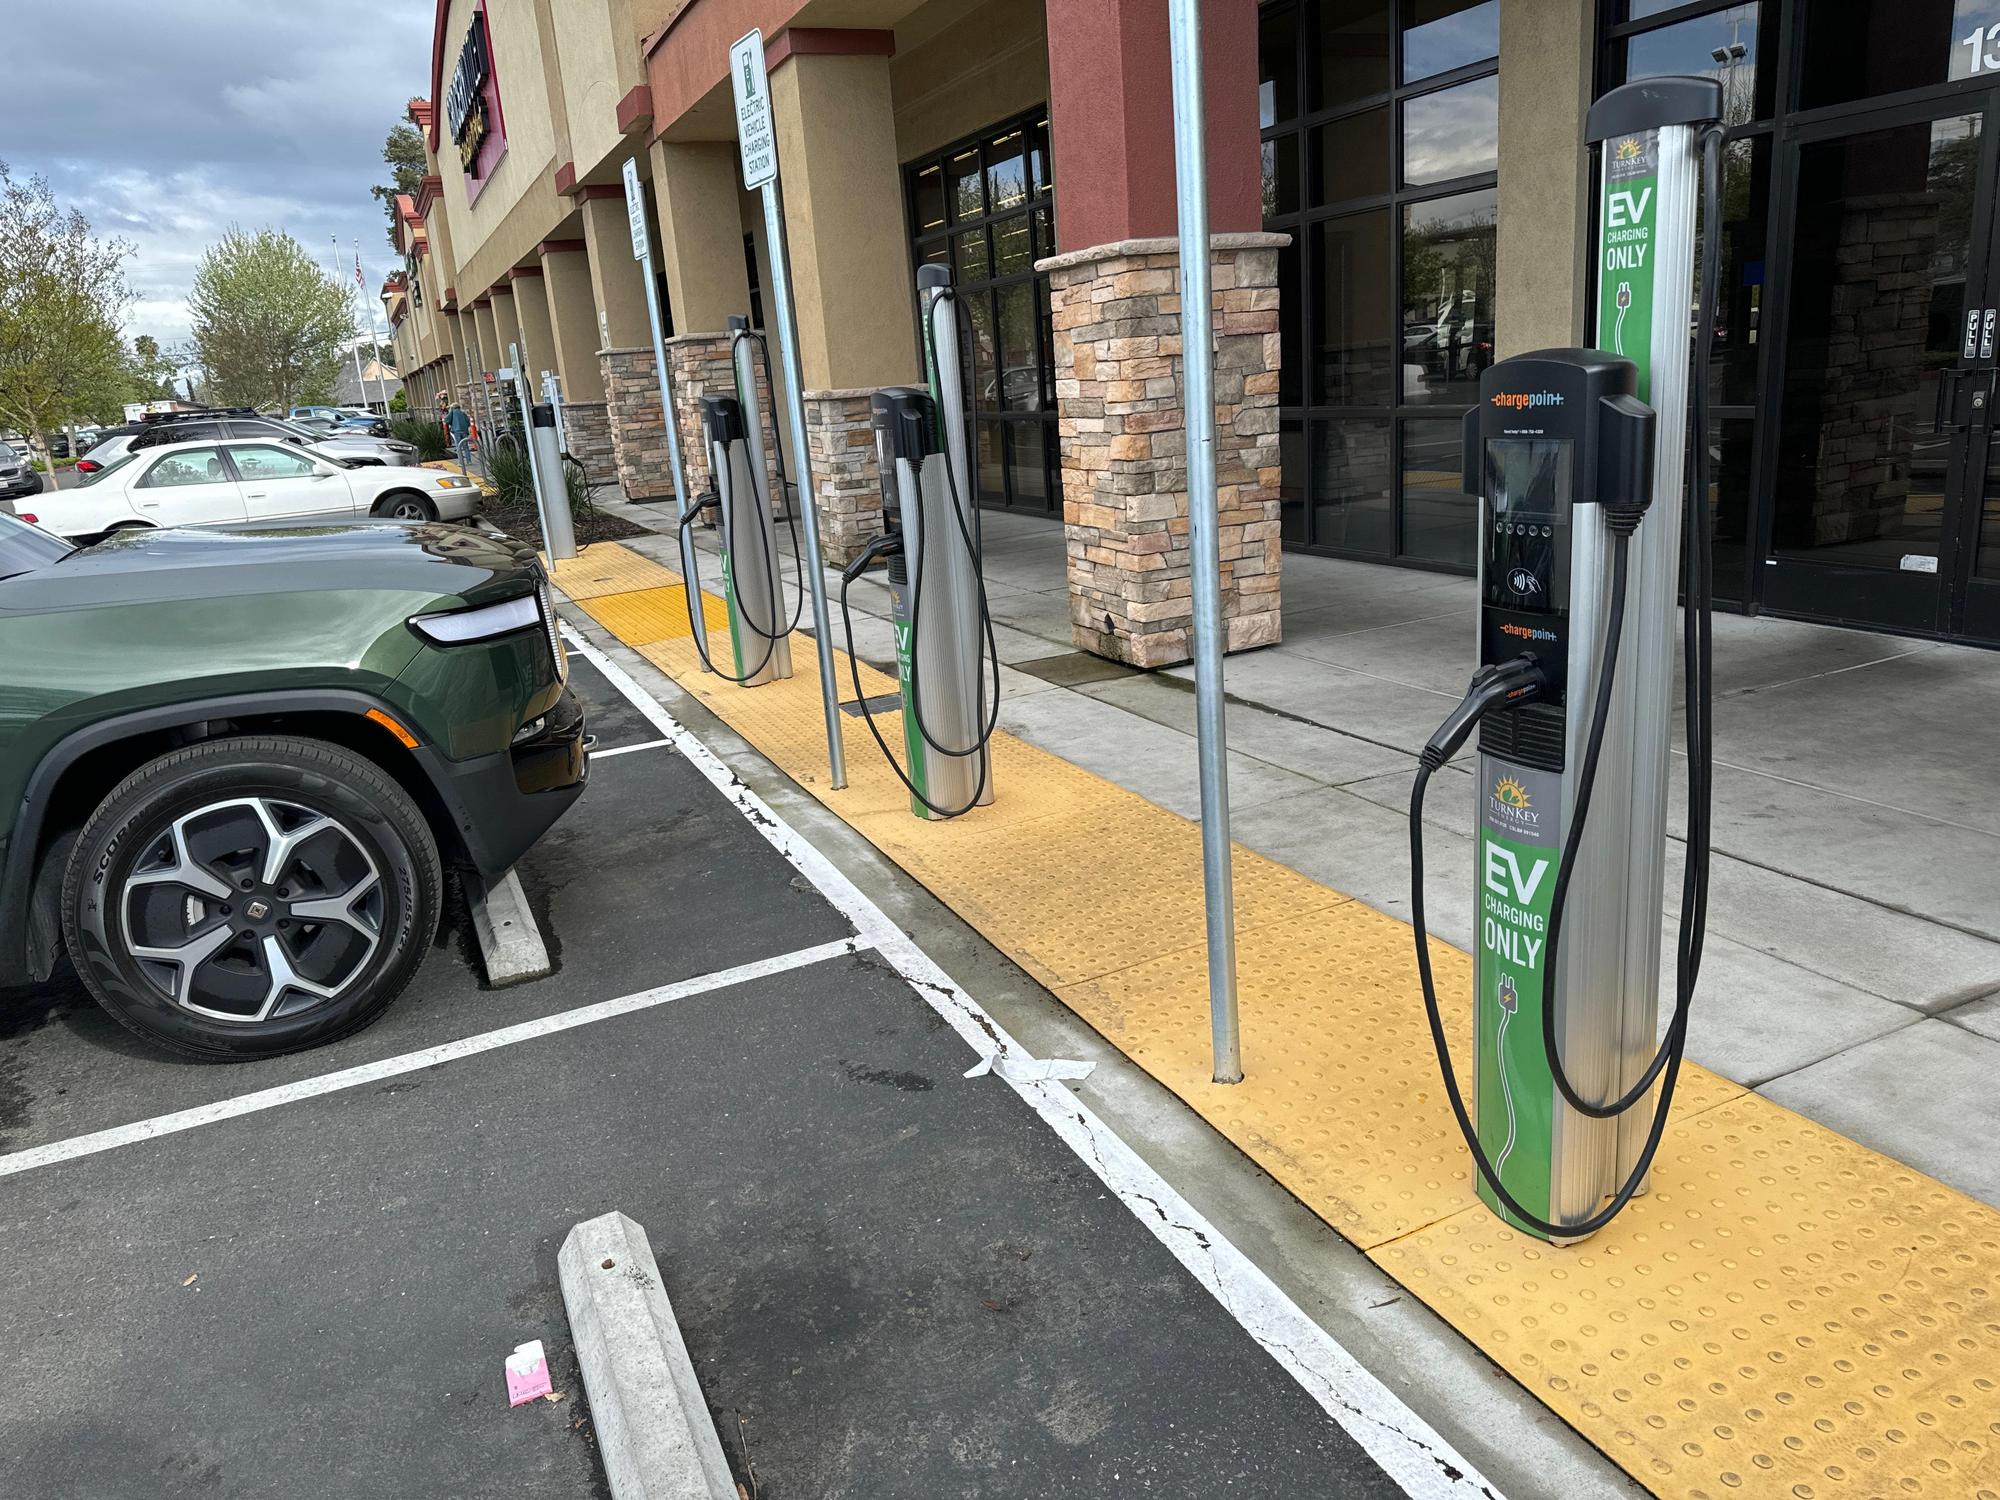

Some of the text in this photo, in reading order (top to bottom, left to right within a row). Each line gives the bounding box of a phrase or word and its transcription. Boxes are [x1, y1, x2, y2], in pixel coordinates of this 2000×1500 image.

[741, 96, 764, 121] ELECTRIC
[744, 115, 766, 139] VEHICLE
[744, 133, 770, 158] CHARGING
[748, 154, 769, 173] STATION
[1608, 186, 1652, 228] EV
[1607, 226, 1648, 244] CHARGING
[1606, 243, 1647, 271] ONLY
[1967, 314, 1978, 347] PULL
[1983, 313, 1994, 346] PULL
[1486, 839, 1550, 906] EV
[398, 865, 413, 924] 275/55
[1485, 893, 1544, 932] CHARGING
[1485, 917, 1543, 969] ONLY
